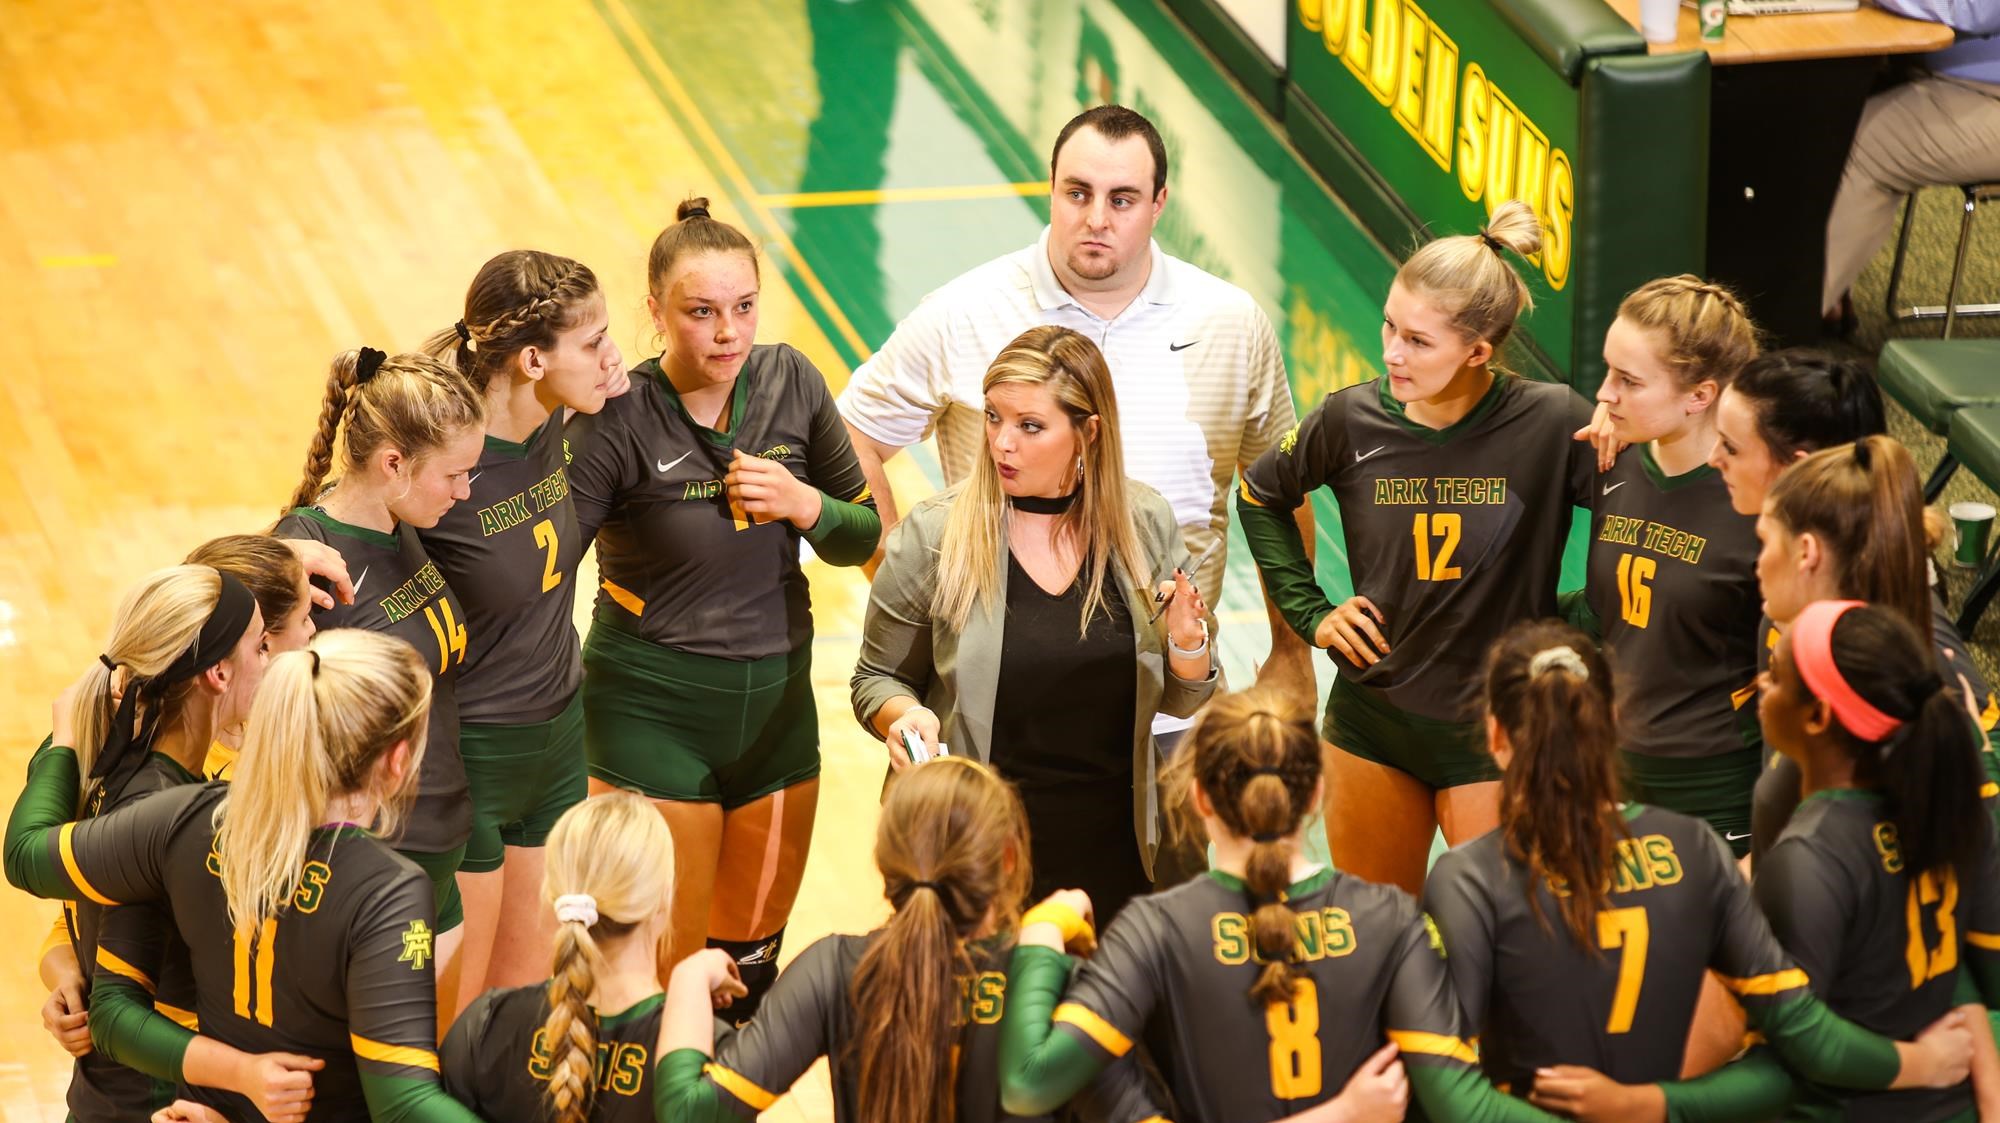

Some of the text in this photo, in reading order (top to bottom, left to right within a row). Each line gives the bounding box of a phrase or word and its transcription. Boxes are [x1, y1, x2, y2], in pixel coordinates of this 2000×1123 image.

[1296, 0, 1459, 173] LDEN
[477, 467, 569, 537] ARK TECH
[683, 480, 727, 500] AR
[1374, 477, 1506, 505] ARK TECH
[532, 518, 562, 593] 2
[1412, 513, 1462, 581] 12
[1598, 514, 1707, 564] ARK TECH
[379, 559, 446, 624] ARK TE
[1616, 553, 1657, 629] 16
[423, 596, 468, 675] 14
[233, 915, 278, 1028] 11
[1211, 906, 1357, 966] SNS
[1596, 906, 1650, 1034] 7
[1266, 977, 1322, 1100] 8
